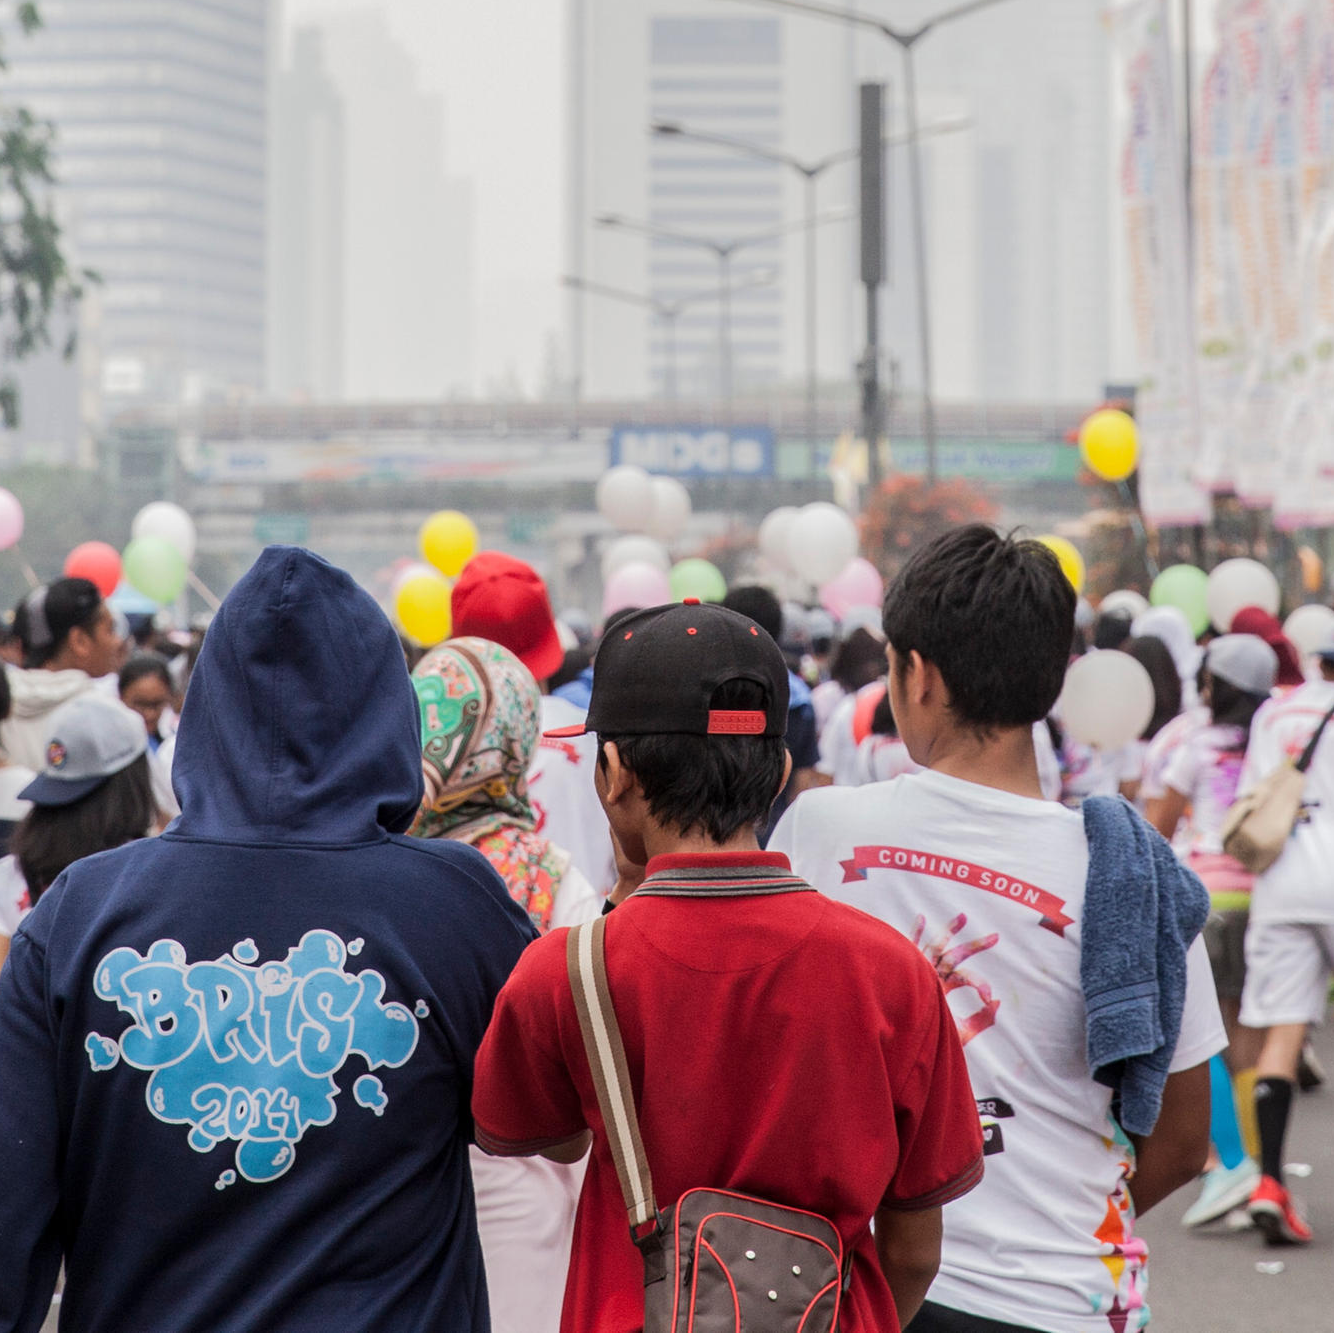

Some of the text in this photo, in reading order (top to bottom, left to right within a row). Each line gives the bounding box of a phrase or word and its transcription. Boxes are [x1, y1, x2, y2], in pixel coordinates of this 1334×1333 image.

[878, 849, 1041, 905] COMING SOON
[191, 1081, 301, 1142] 2014
